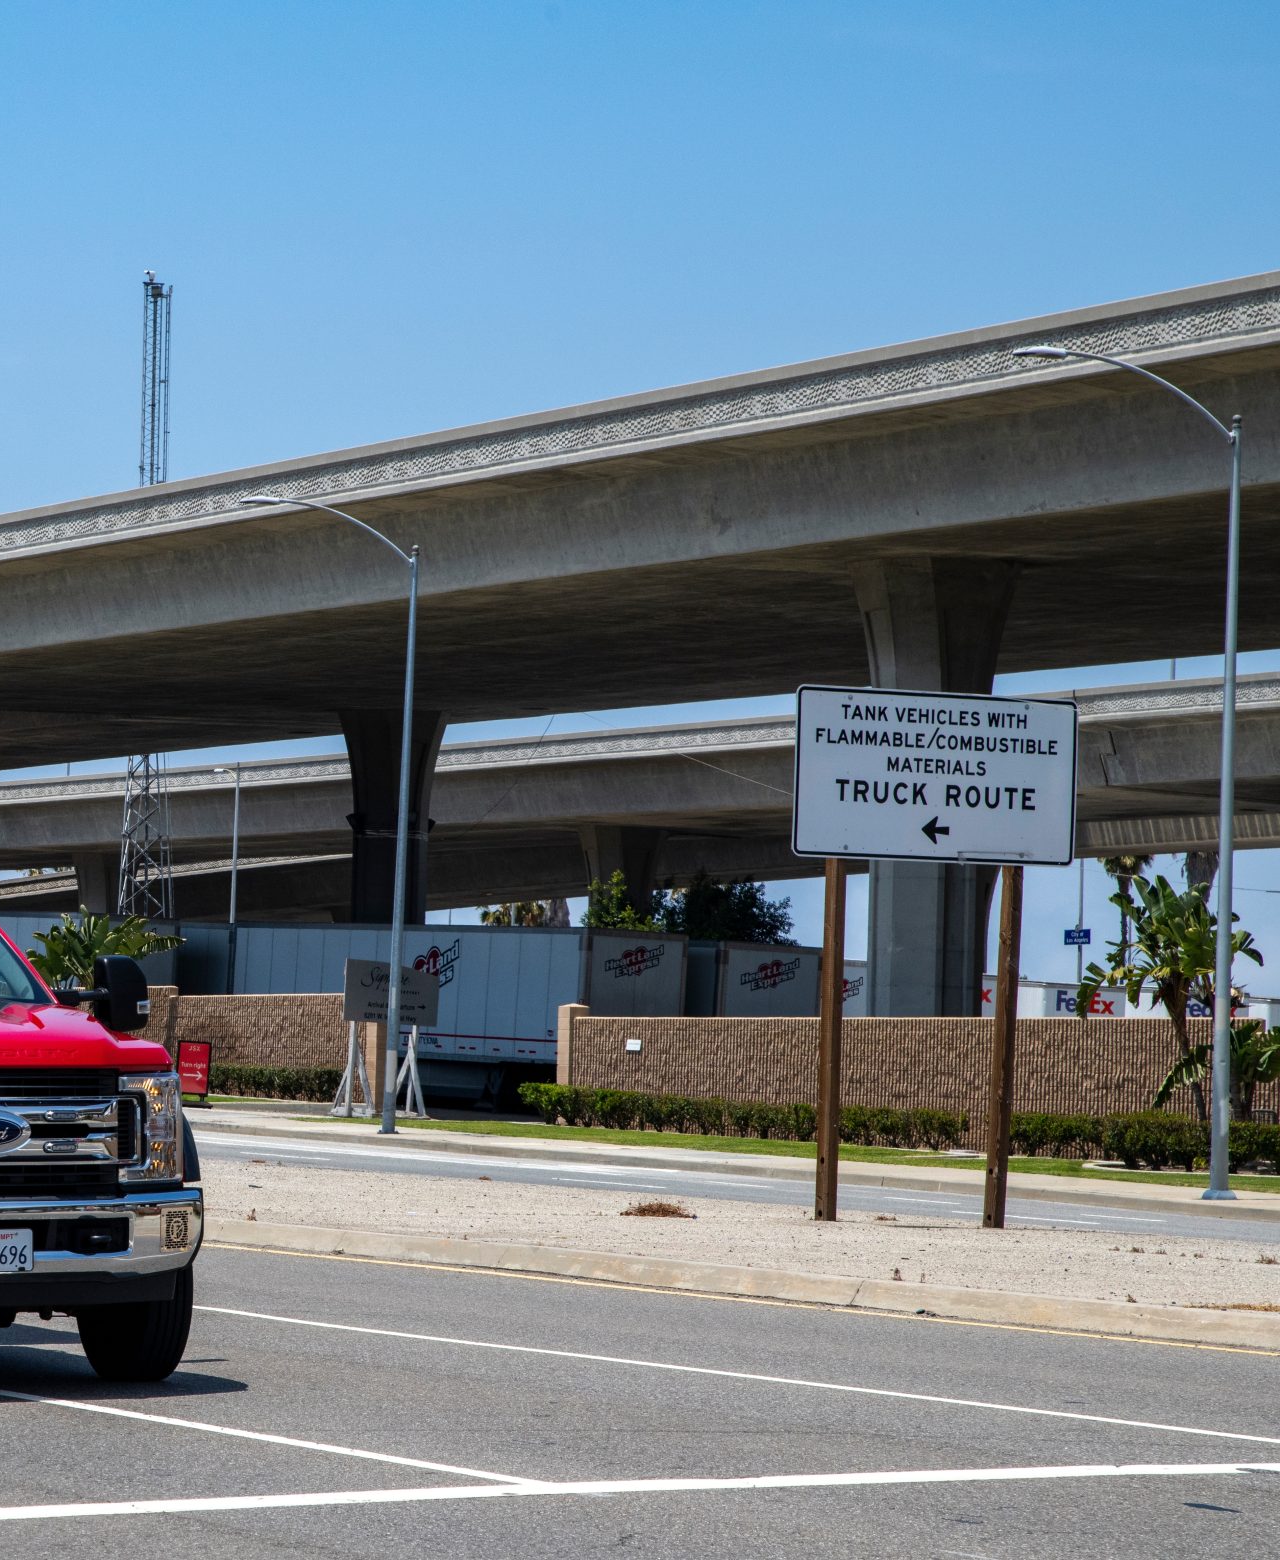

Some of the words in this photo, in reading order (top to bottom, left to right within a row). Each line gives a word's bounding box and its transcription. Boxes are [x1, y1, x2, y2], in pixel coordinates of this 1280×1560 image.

[841, 704, 889, 722] TANK
[895, 707, 981, 727] VEHICLES
[987, 712, 1028, 729] WITH
[815, 727, 1058, 756] FLAMMABLE/COMBUSTIBLE
[886, 756, 987, 776] MATERIALS
[835, 779, 928, 805] TRUCK
[945, 784, 1037, 811] ROUTE
[605, 944, 665, 972] HeartLand
[615, 957, 660, 978] Express
[741, 958, 800, 985] HeartLand
[751, 971, 796, 991] Express
[1056, 990, 1115, 1015] FeEx
[1, 1048, 77, 1059] DUTY
[193, 1062, 207, 1070] right
